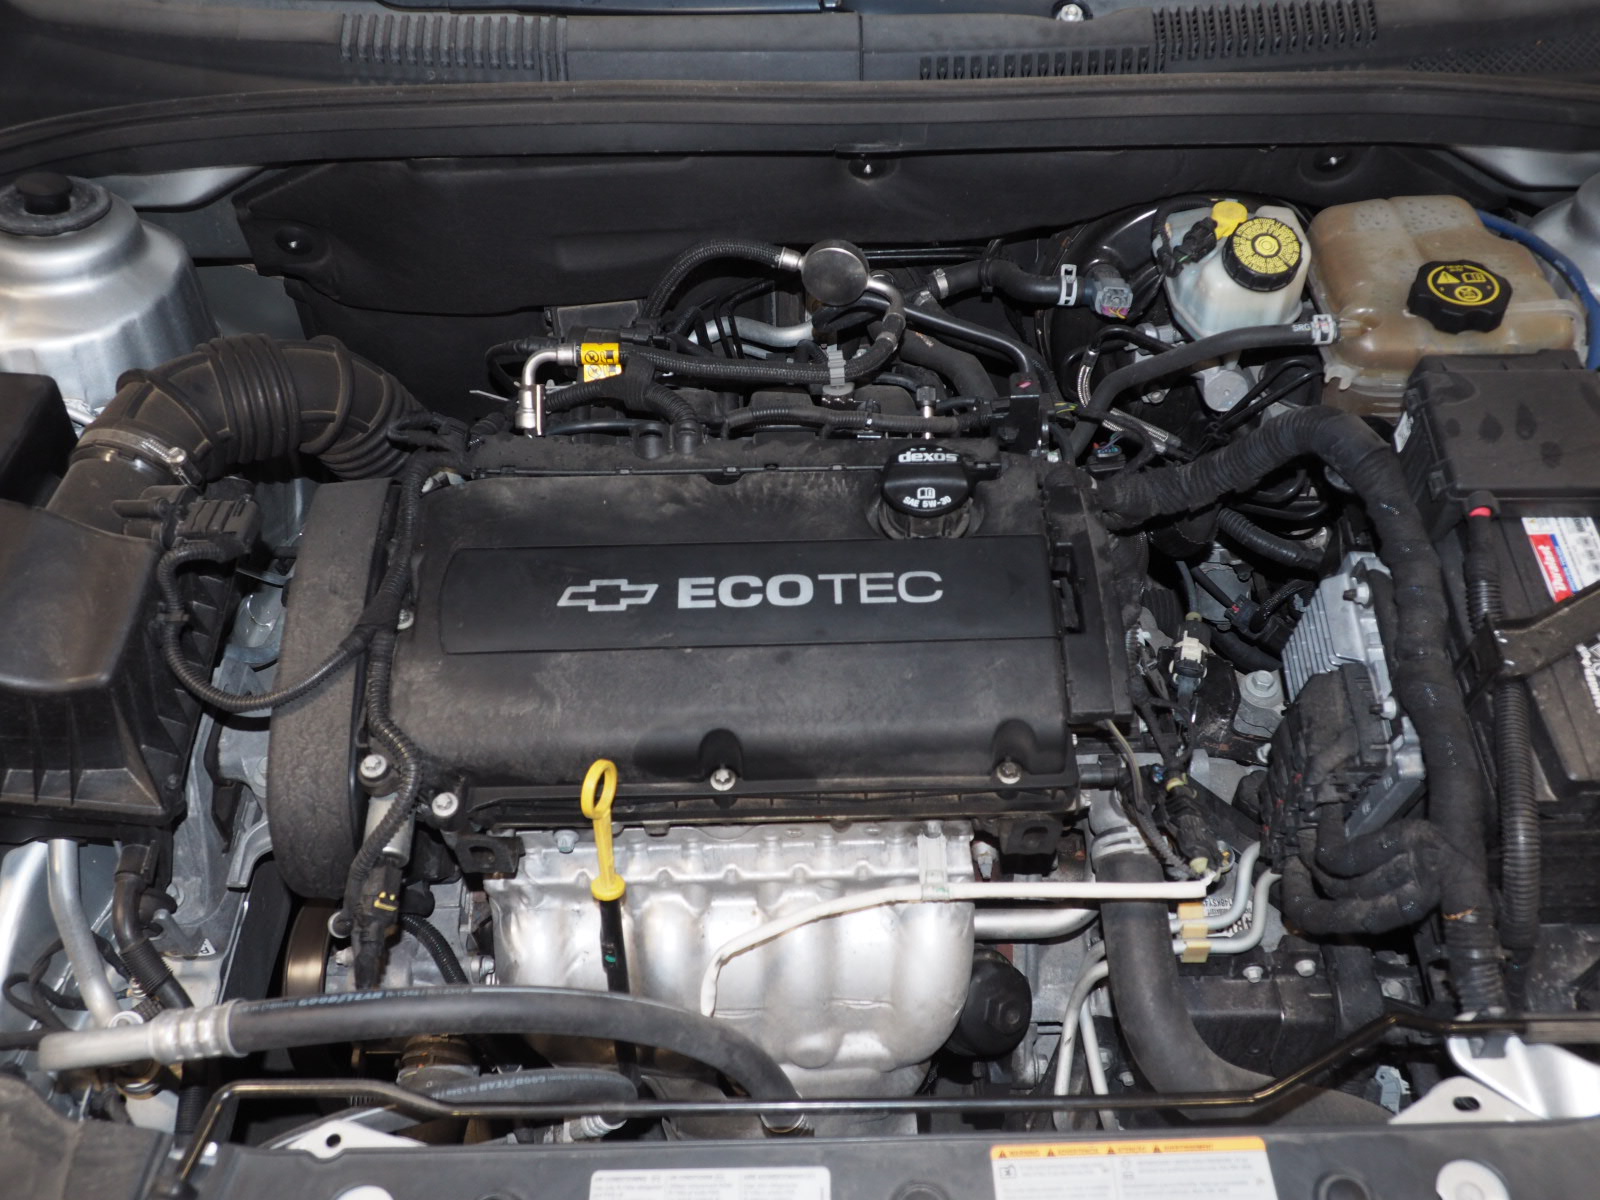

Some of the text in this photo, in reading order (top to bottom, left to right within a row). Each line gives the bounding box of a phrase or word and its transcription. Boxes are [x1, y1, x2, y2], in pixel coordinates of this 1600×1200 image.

[898, 451, 959, 463] dexos
[902, 495, 952, 508] SAE 5W-30
[1538, 544, 1567, 592] Duralast
[677, 571, 943, 609] ECOTEC
[298, 991, 384, 1006] GOODYEAR
